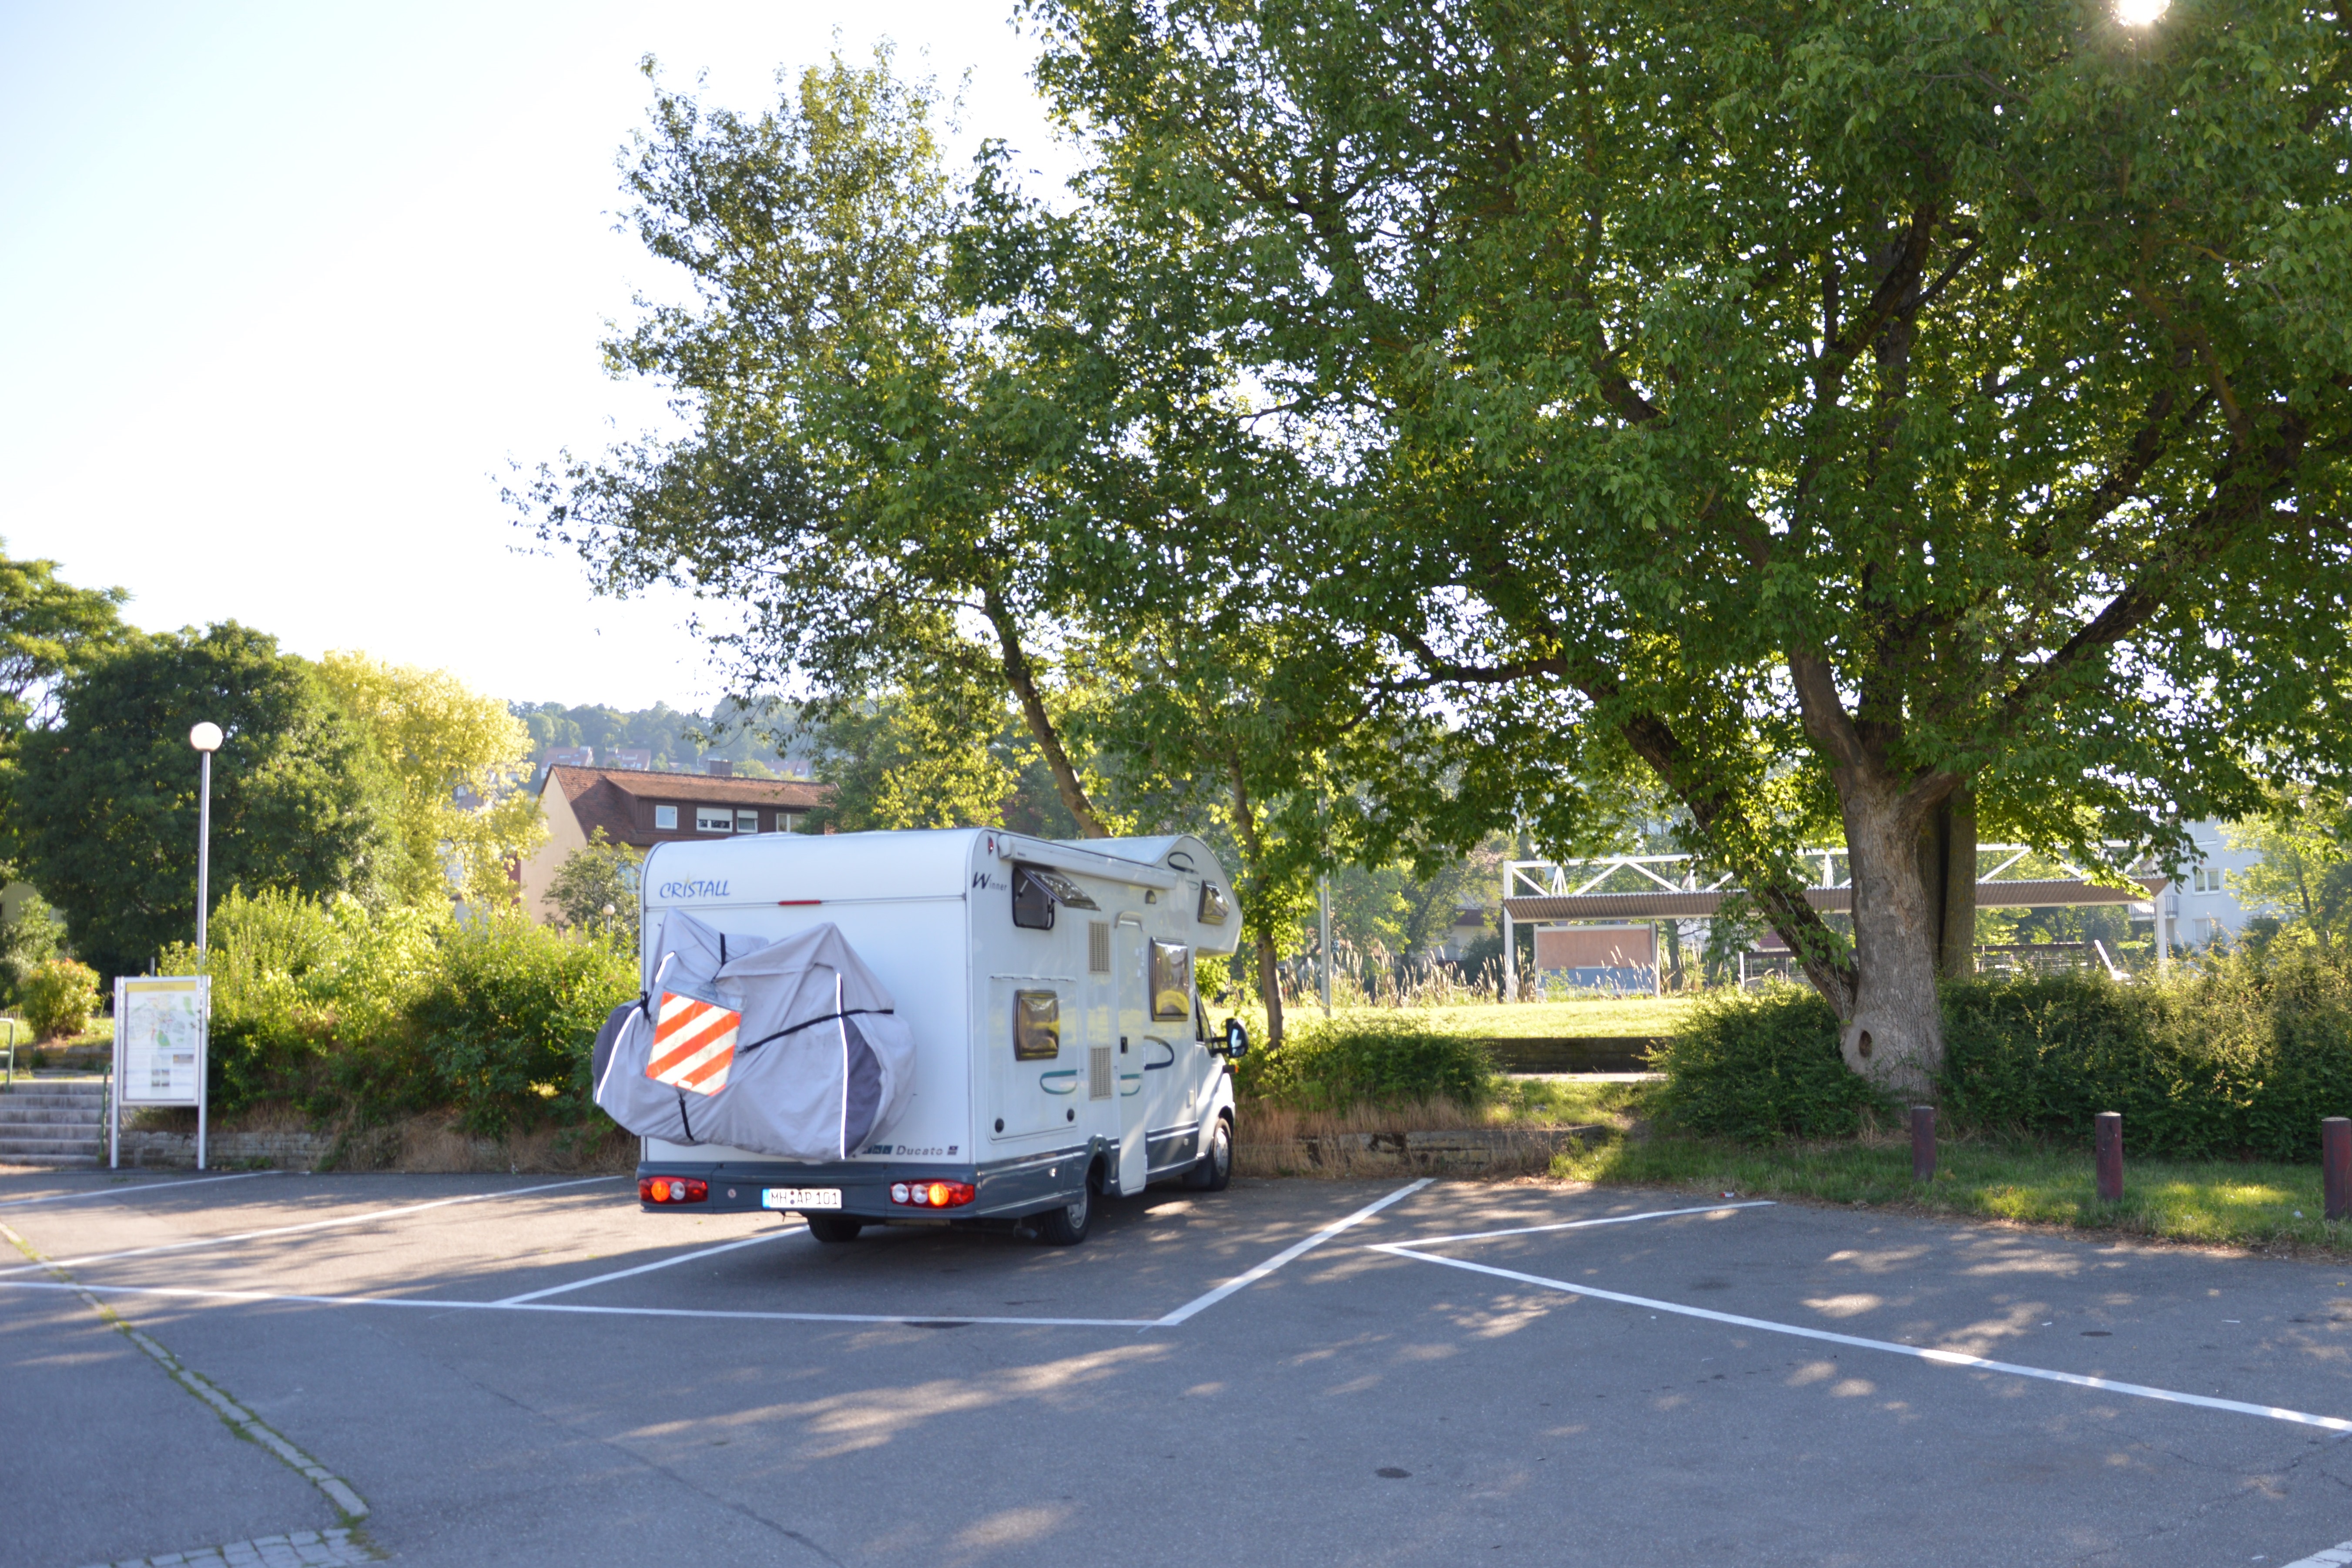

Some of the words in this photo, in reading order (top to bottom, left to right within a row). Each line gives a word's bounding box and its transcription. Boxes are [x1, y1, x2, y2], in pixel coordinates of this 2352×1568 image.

[660, 880, 730, 898] CRISTALL
[972, 871, 1007, 891] Winner
[896, 1145, 943, 1156] Ducato
[771, 1192, 787, 1204] MH
[797, 1191, 812, 1204] AP
[816, 1191, 838, 1205] 101
